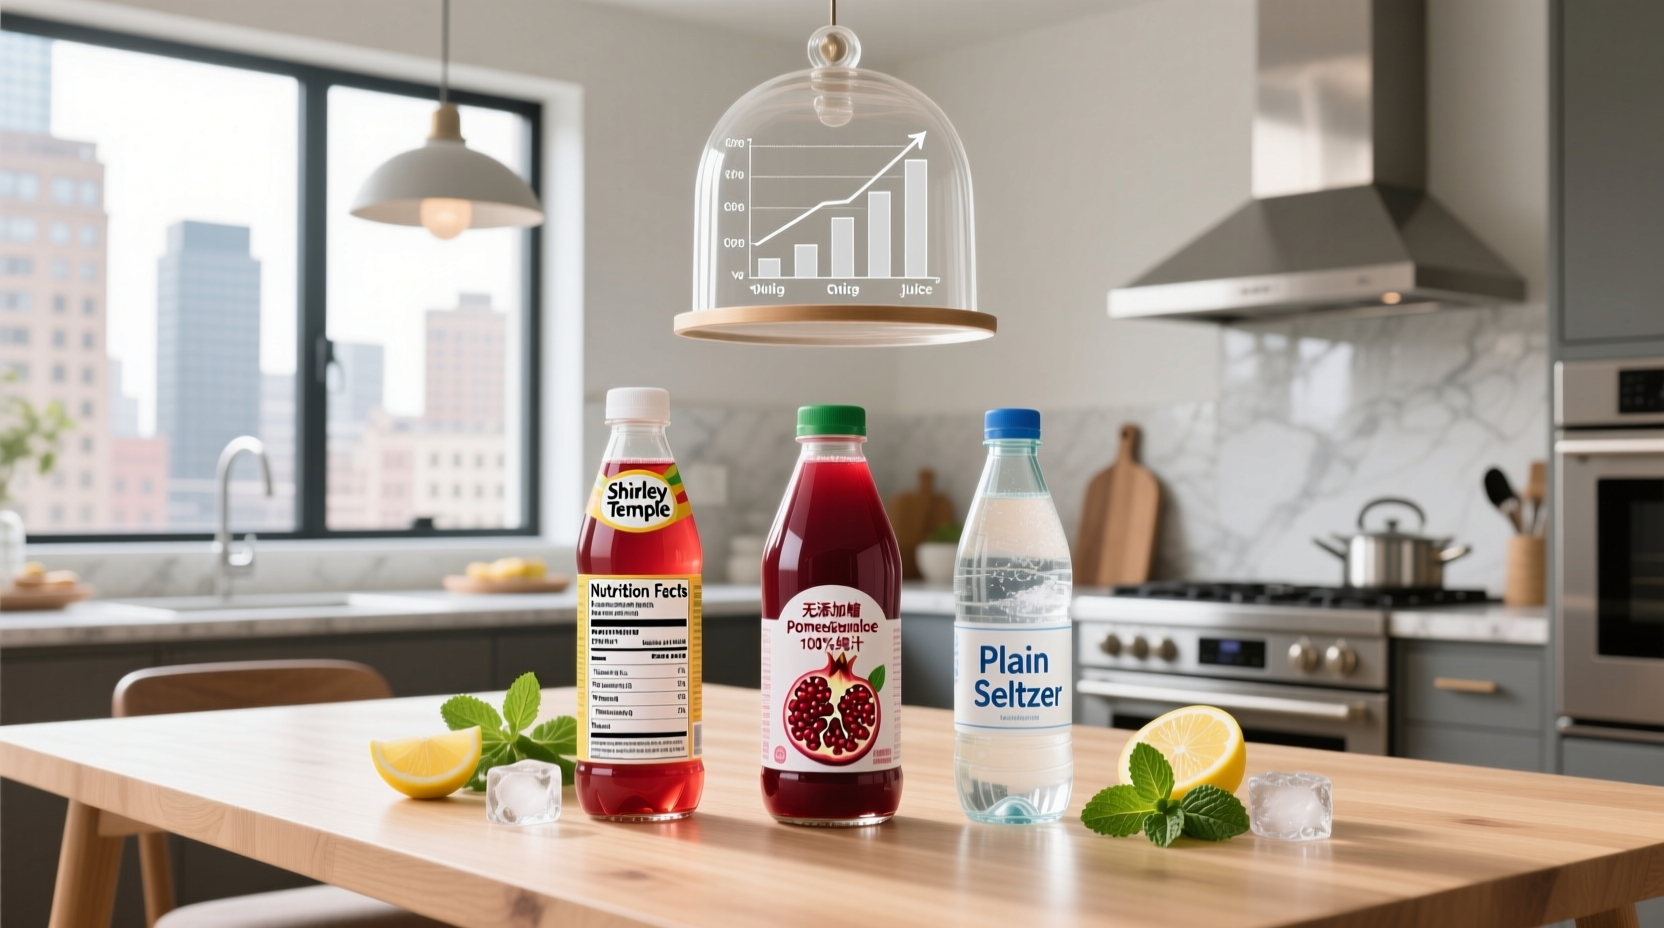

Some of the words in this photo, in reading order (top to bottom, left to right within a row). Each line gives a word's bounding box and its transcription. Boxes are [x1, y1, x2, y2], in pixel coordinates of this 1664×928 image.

[607, 480, 668, 504] Shirley
[607, 500, 670, 522] Temple
[591, 583, 650, 598] Nutrition
[980, 645, 1048, 674] Plain
[974, 679, 1063, 708] Seltzer
